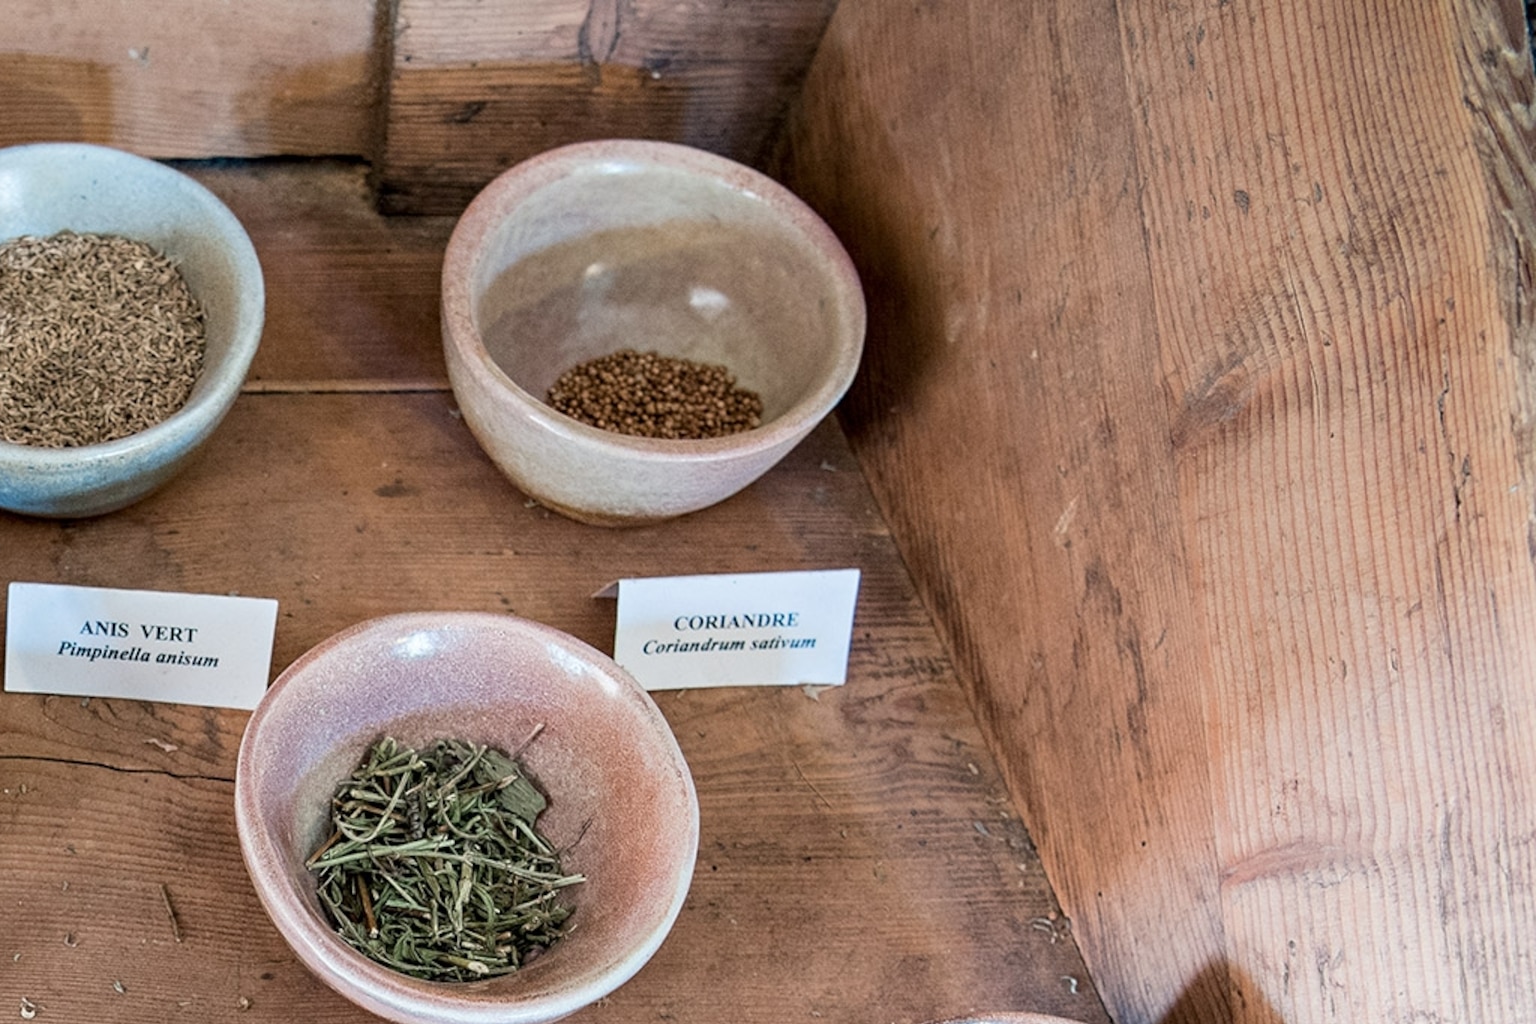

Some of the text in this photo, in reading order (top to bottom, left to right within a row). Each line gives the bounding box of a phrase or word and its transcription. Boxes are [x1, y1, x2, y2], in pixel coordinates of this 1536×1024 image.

[80, 620, 197, 643] ANIS VERT
[673, 612, 799, 632] CORIANDRE
[57, 640, 220, 668] Pimpinella anisum
[643, 635, 817, 656] Coriandrum sativum
